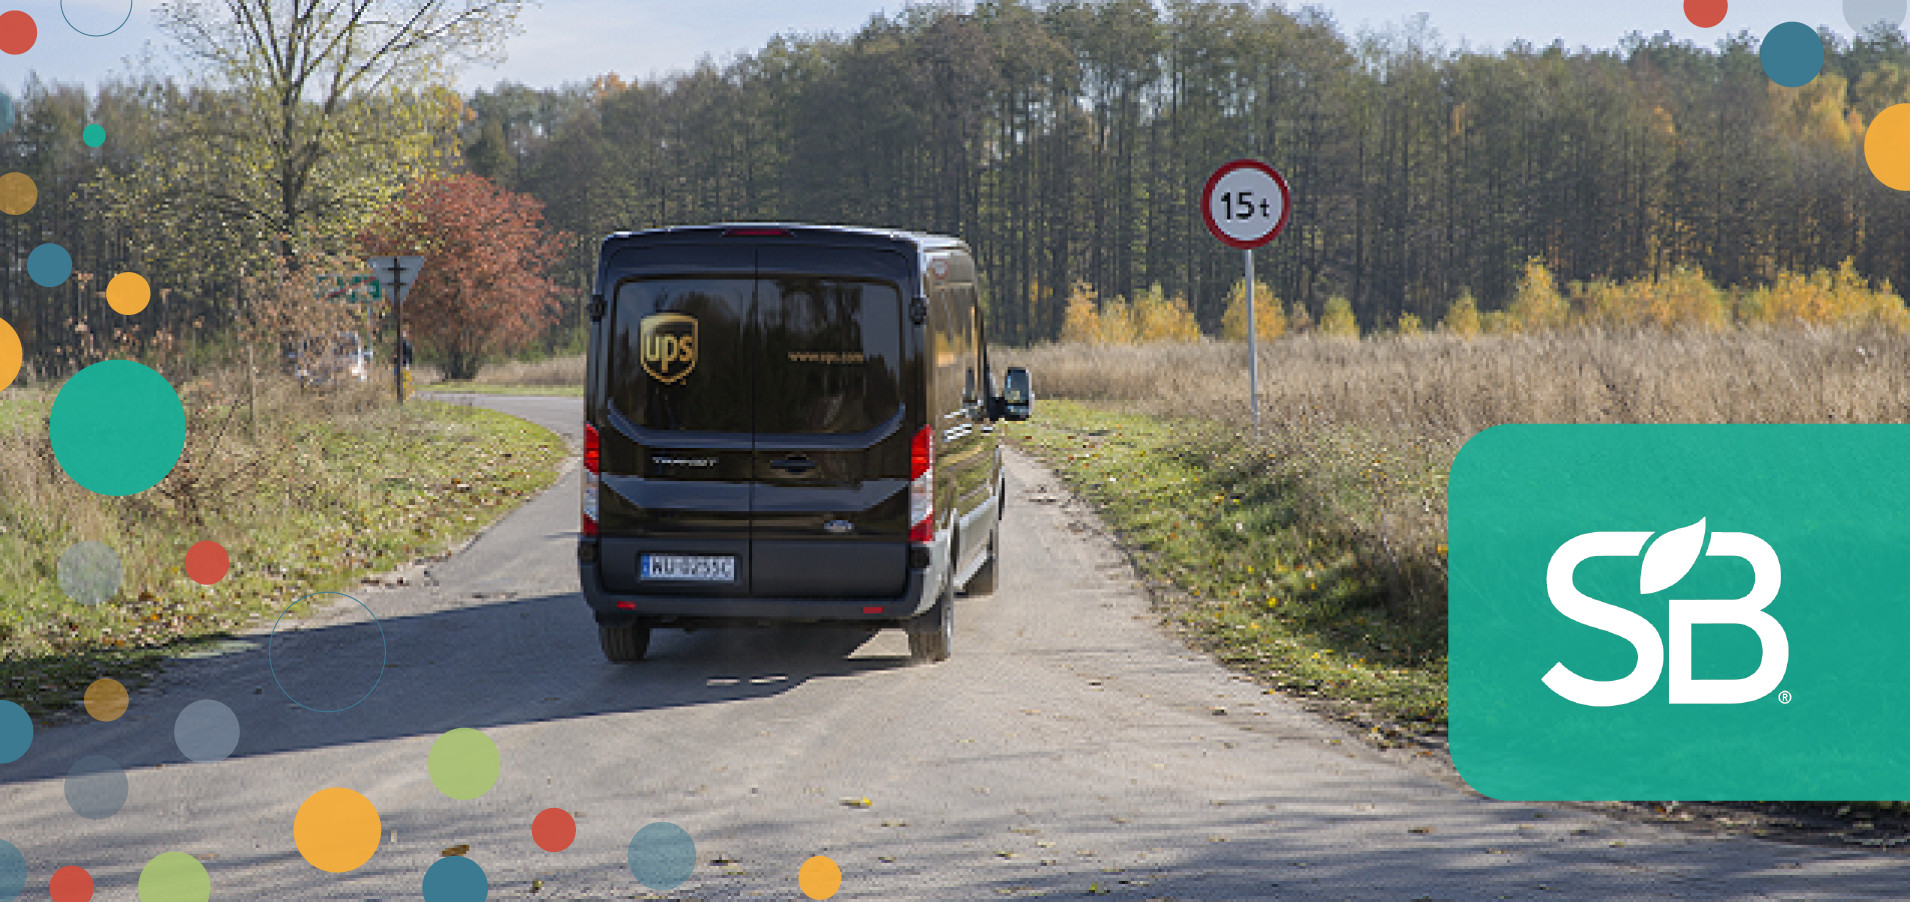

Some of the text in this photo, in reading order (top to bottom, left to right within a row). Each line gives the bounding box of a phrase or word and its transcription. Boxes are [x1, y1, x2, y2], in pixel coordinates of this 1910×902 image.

[1220, 191, 1270, 220] 15 t
[646, 334, 693, 373] ups
